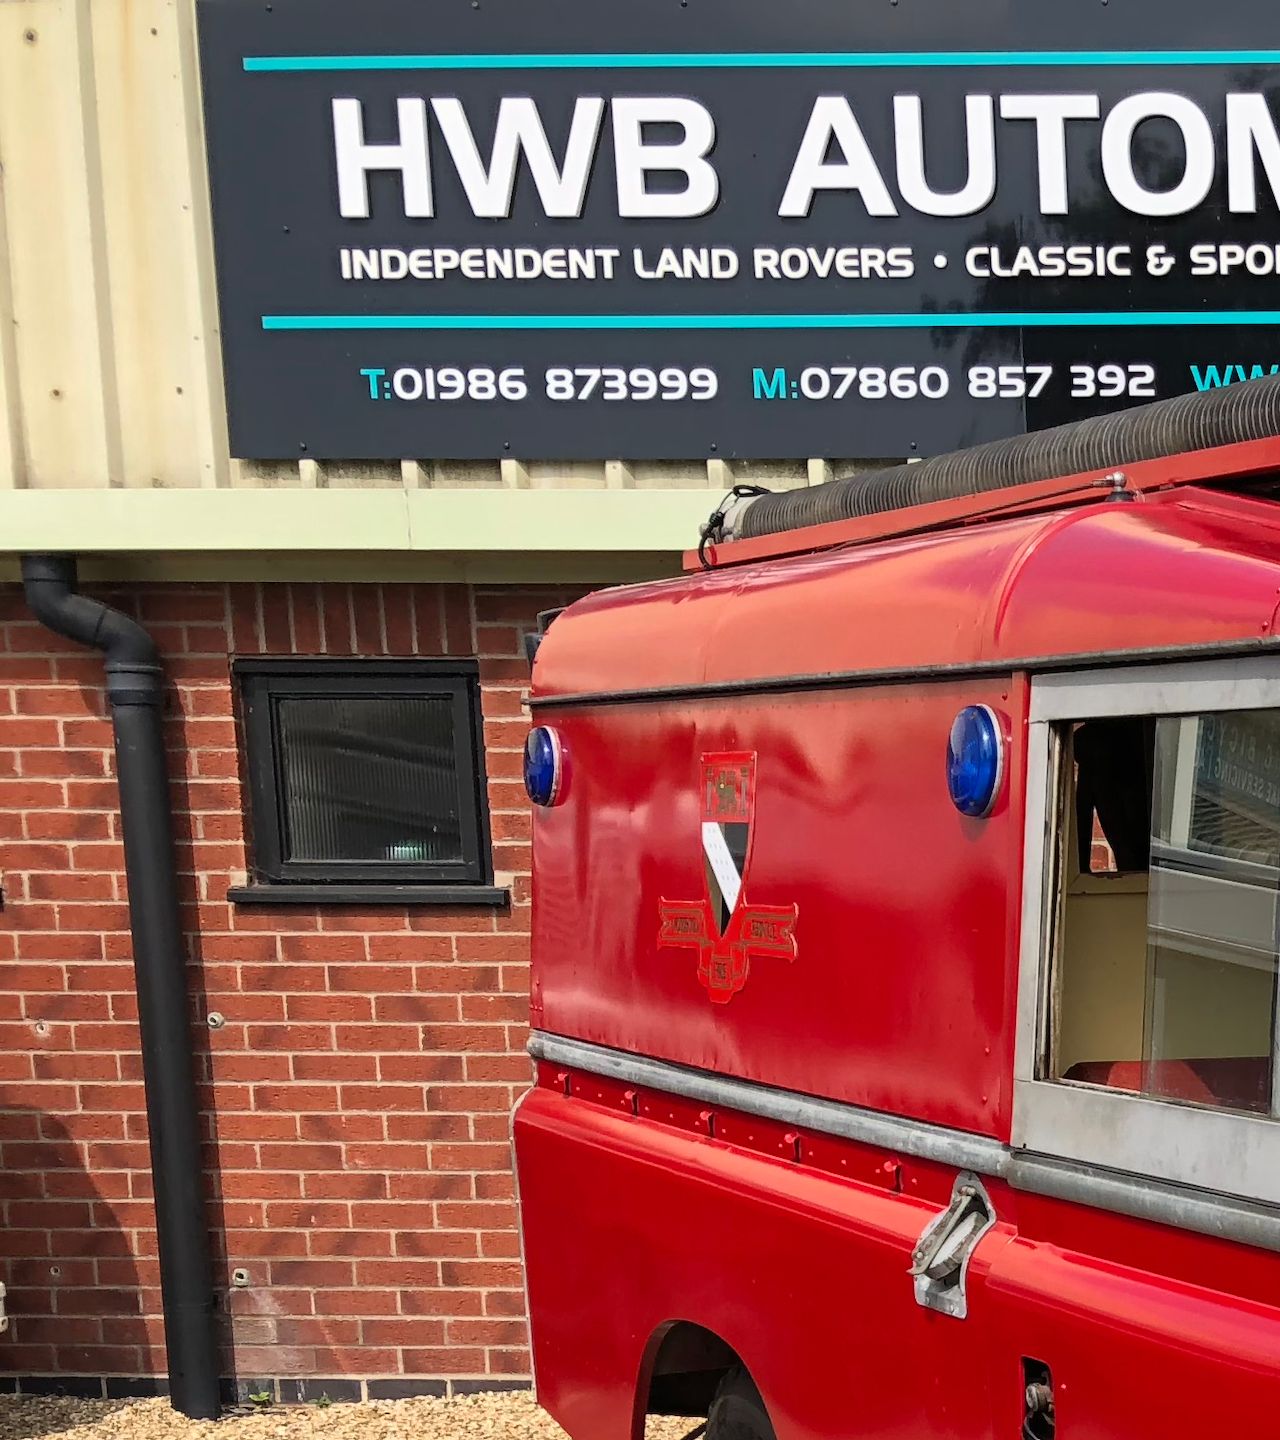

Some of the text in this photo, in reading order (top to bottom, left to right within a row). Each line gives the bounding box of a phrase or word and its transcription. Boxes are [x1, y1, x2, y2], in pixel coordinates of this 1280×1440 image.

[332, 96, 719, 218] HWB
[340, 248, 620, 280] INDEPENDENT
[633, 247, 739, 279] LAND
[753, 247, 915, 279] ROVERS
[965, 245, 1131, 277] CLASSIC
[1146, 245, 1176, 276] &
[545, 367, 719, 401] 873999
[968, 365, 1053, 398] 857
[1070, 364, 1156, 397] 392
